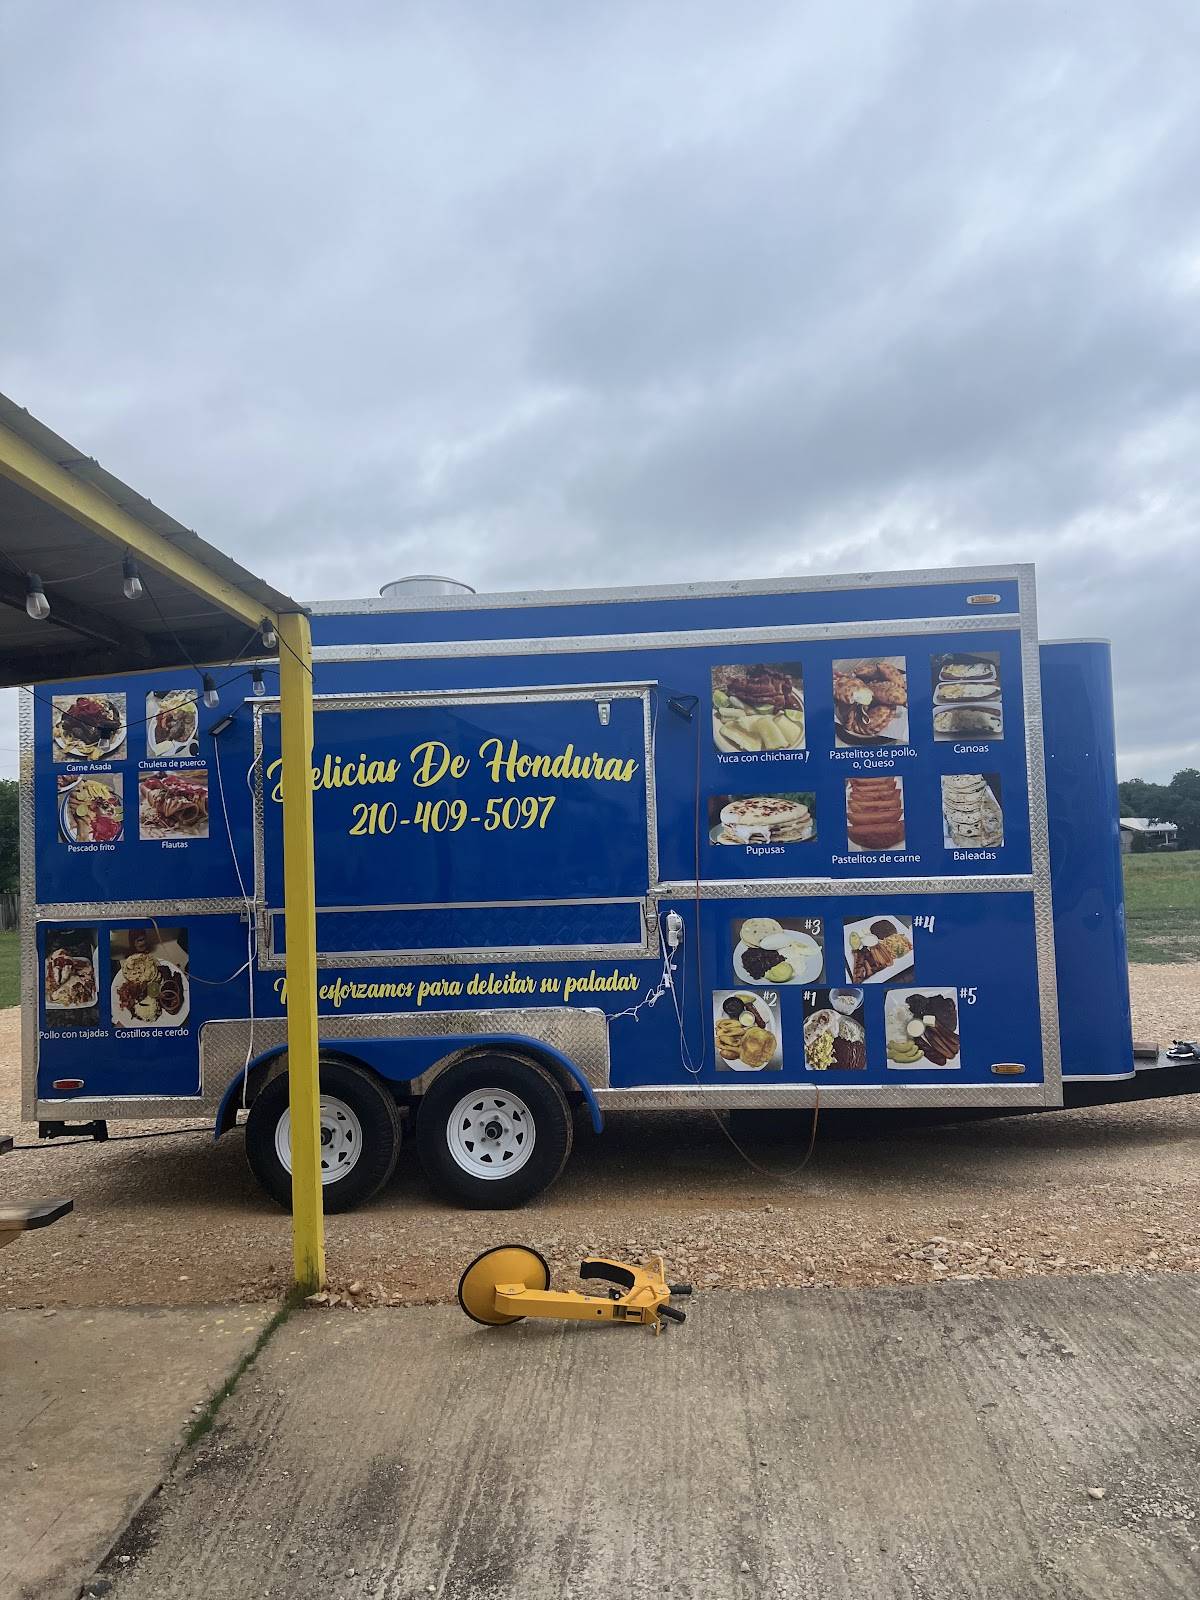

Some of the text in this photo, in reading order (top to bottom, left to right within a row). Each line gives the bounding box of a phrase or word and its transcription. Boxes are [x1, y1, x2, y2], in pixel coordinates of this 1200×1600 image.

[829, 747, 918, 760] Pastelitos de pollo,
[953, 743, 989, 755] Canoas
[138, 760, 207, 769] Chuleta de puerco
[410, 740, 470, 788] De
[479, 737, 640, 784] Honduras
[717, 754, 739, 763] Yuca
[741, 754, 758, 763] con
[863, 758, 895, 769] Queso
[66, 763, 112, 772] Carne Asada
[349, 795, 556, 837] 210-409-5097
[67, 843, 116, 853] Pescado frito
[161, 840, 188, 849] Flautas
[746, 846, 785, 857] Pupusas
[953, 849, 997, 861] Baleadas
[832, 853, 921, 865] Pastelitos de carne
[804, 919, 822, 935] #3
[913, 915, 935, 933] #4
[319, 977, 415, 1008] esforzamos
[417, 978, 464, 1006] para
[466, 970, 537, 995] deleitar
[540, 975, 561, 994] su
[563, 968, 640, 1002] paladar
[762, 991, 778, 1007] #2
[803, 990, 817, 1007] #1
[959, 987, 978, 1005] #5
[39, 1030, 60, 1039] Pollo
[79, 1028, 109, 1040] tajadas
[152, 1028, 163, 1038] de
[165, 1028, 189, 1038] cerdo
